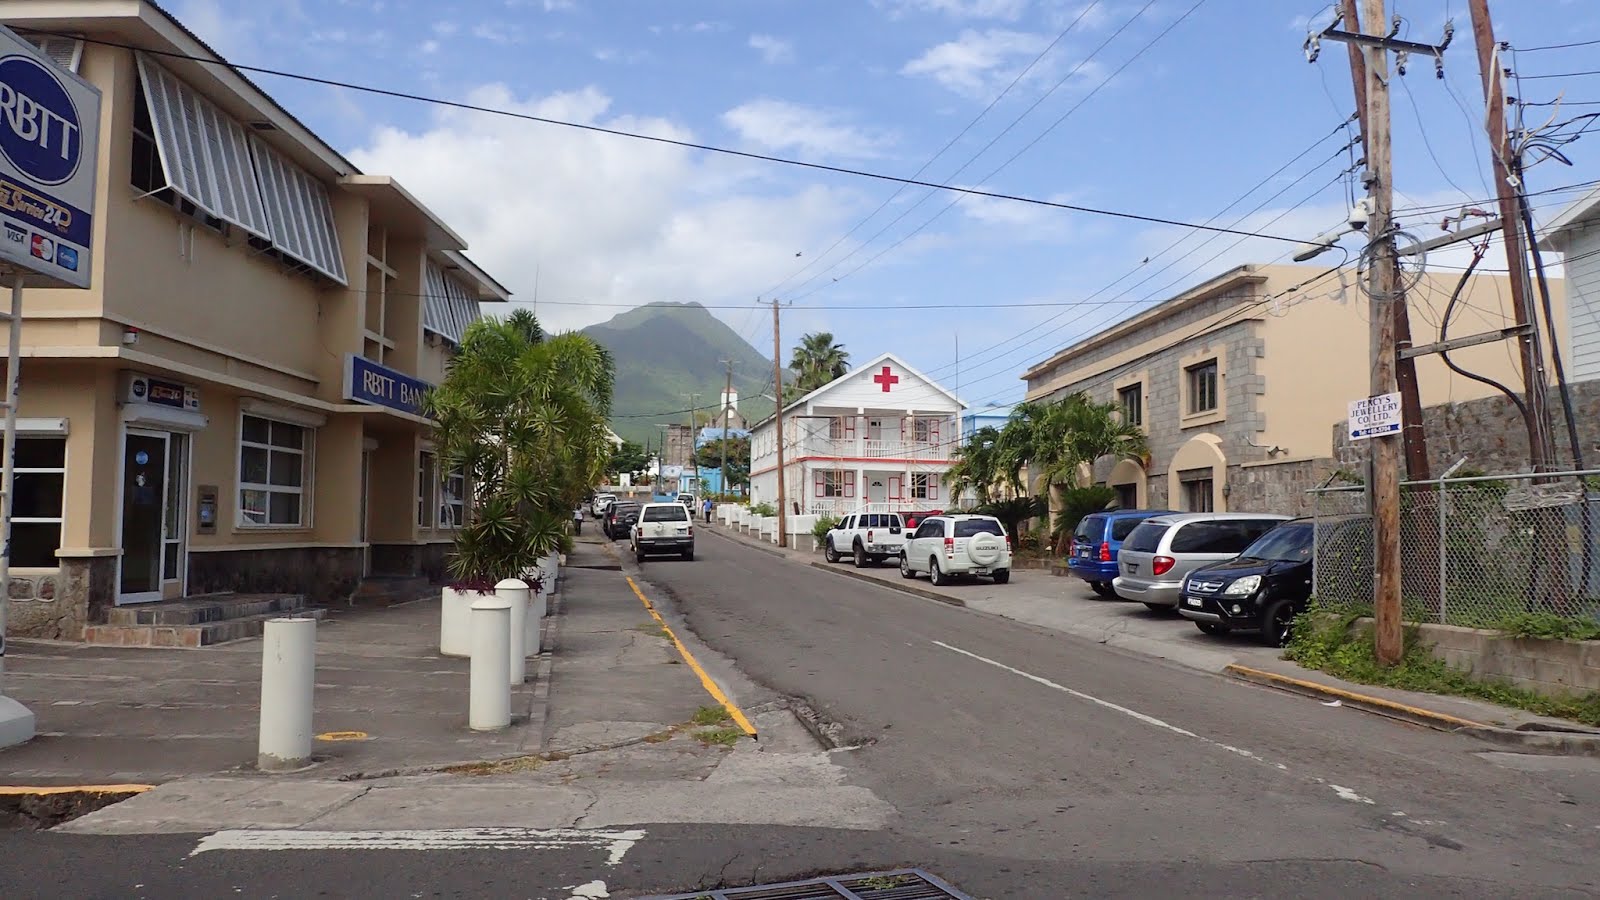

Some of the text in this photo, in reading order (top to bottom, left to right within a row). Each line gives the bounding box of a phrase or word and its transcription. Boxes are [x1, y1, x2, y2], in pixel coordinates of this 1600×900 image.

[0, 82, 78, 161] RBTT
[7, 230, 25, 245] VISA
[363, 369, 395, 400] RBTT
[1350, 402, 1398, 418] JEWELLERY
[1357, 396, 1391, 409] PERCY'S
